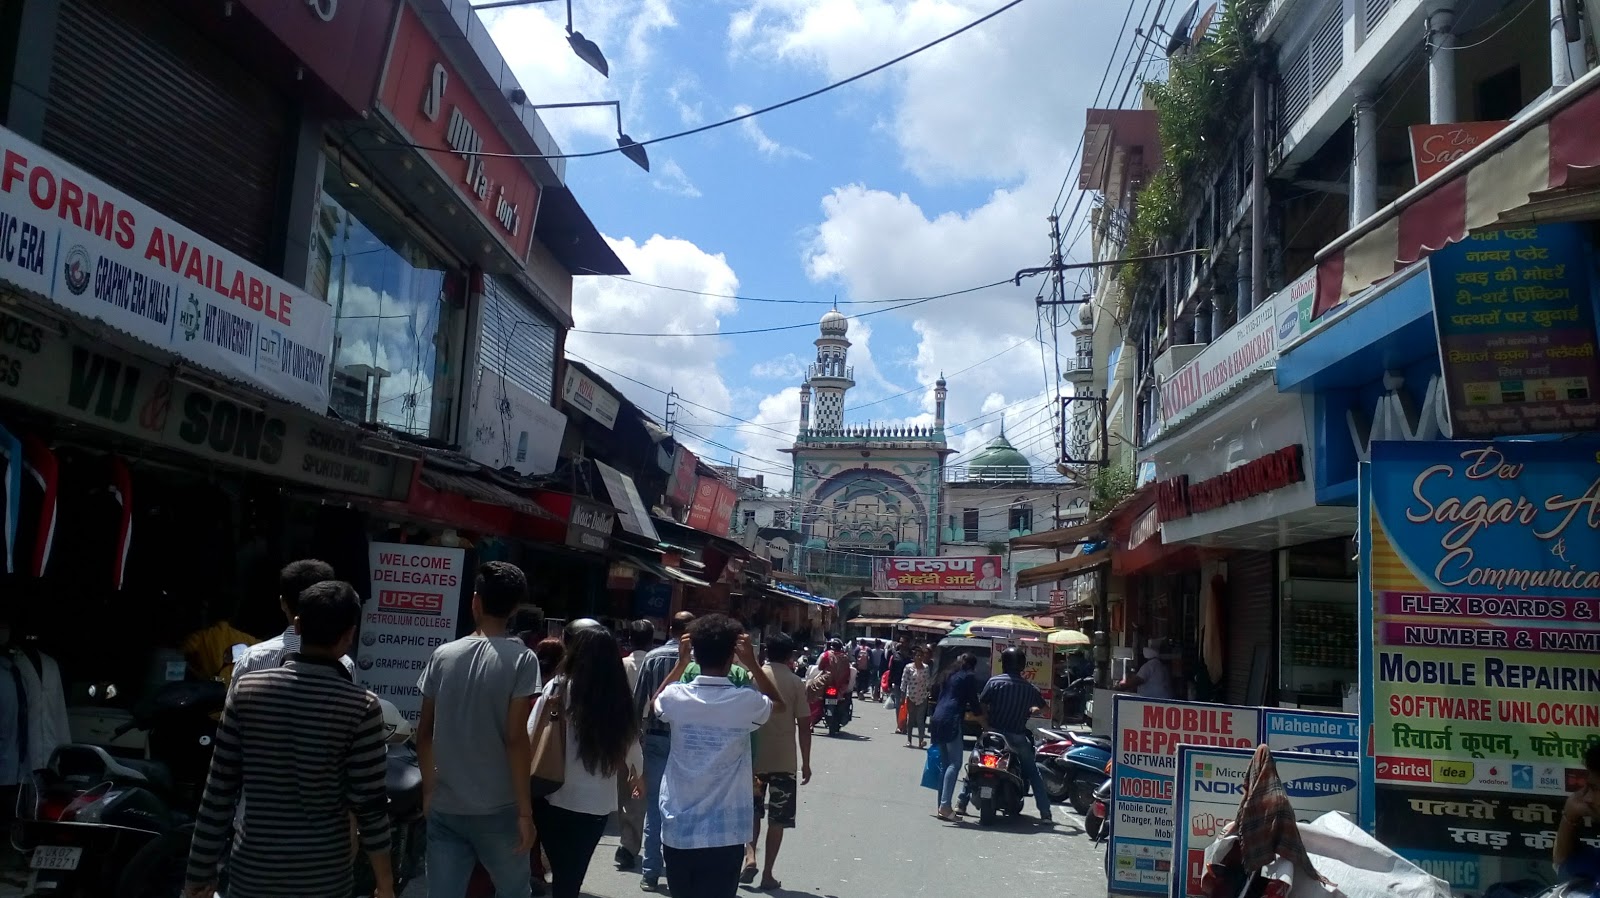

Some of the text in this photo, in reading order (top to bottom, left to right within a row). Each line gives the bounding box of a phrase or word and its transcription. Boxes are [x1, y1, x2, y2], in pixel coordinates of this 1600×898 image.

[1448, 129, 1478, 145] Dev
[1, 150, 292, 326] FORMS AVAILABLE
[18, 222, 45, 275] ERA
[1493, 266, 1518, 281] की
[95, 256, 170, 325] GRAPHIC ERA HILLS
[180, 310, 194, 327] HIT
[1504, 311, 1528, 323] पर
[203, 303, 254, 357] HIT UNIVERSITY
[293, 343, 326, 386] UNIVERSITY
[1162, 361, 1202, 421] KOHLI
[1233, 326, 1275, 376] HANDICRAFT
[180, 392, 287, 464] SONS
[302, 453, 341, 478] SPORTS
[1460, 446, 1523, 479] Dev
[1406, 464, 1538, 550] Sagar
[379, 553, 452, 570] WELCOME
[1434, 547, 1600, 591] Communica
[374, 569, 457, 587] DELEGATES
[944, 573, 975, 585] आर्ट
[382, 592, 440, 608] UPES
[1401, 595, 1593, 619] FLEX BOARDS &
[367, 613, 451, 629] PETROLIUM COLLEGE
[378, 634, 425, 646] GRAPHIC
[1404, 626, 1508, 648] NUMBER
[1515, 630, 1533, 649] &
[375, 658, 410, 670] GRAPHIC
[1379, 653, 1600, 691] MOBILE REPAIRIN
[373, 684, 389, 695] HIT
[1143, 705, 1233, 734] MOBILE
[1390, 694, 1599, 727] SOFTWARE UNLOCKIN
[1271, 717, 1343, 735] Mahender
[1392, 723, 1453, 750] रिचार्ज
[1391, 762, 1430, 777] airtel
[1120, 777, 1173, 799] MOBILE
[1195, 780, 1244, 795] NOK
[1287, 780, 1347, 793] SAMSUNG
[1118, 802, 1143, 812] Mobile
[1508, 803, 1557, 824] की
[1154, 817, 1173, 827] Mem
